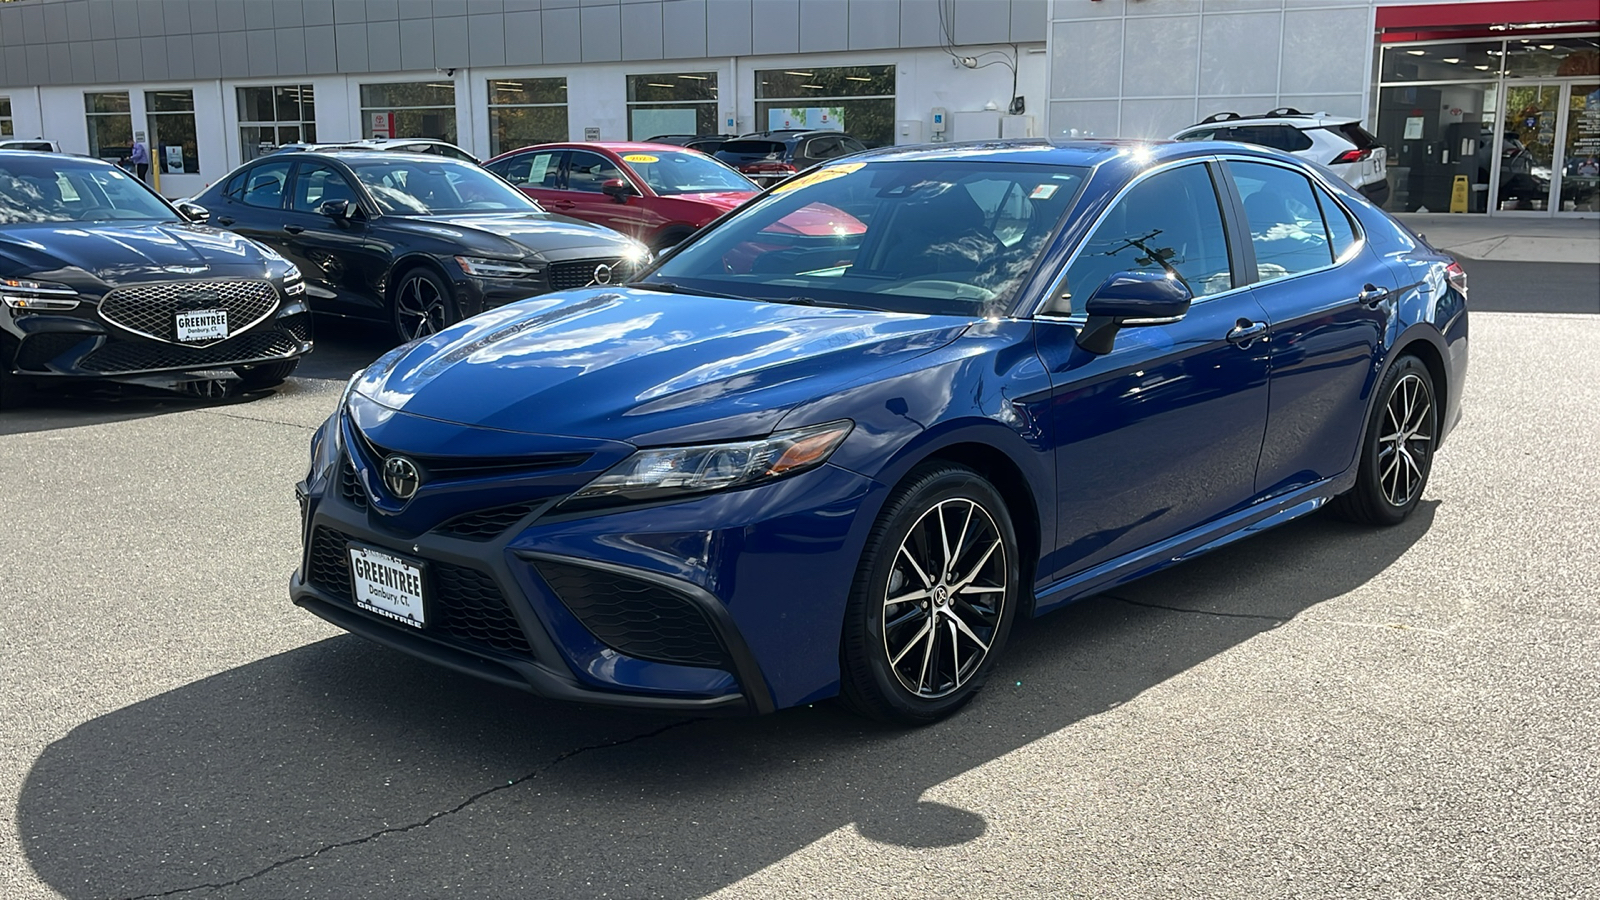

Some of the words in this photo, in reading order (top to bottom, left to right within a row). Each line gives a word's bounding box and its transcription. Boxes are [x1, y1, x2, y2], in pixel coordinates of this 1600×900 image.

[178, 315, 226, 328] GREENTREE
[355, 557, 421, 597] GREENTREE
[368, 584, 400, 605] Danbury,
[400, 594, 410, 607] CT.
[356, 601, 422, 629] GREENTREE
